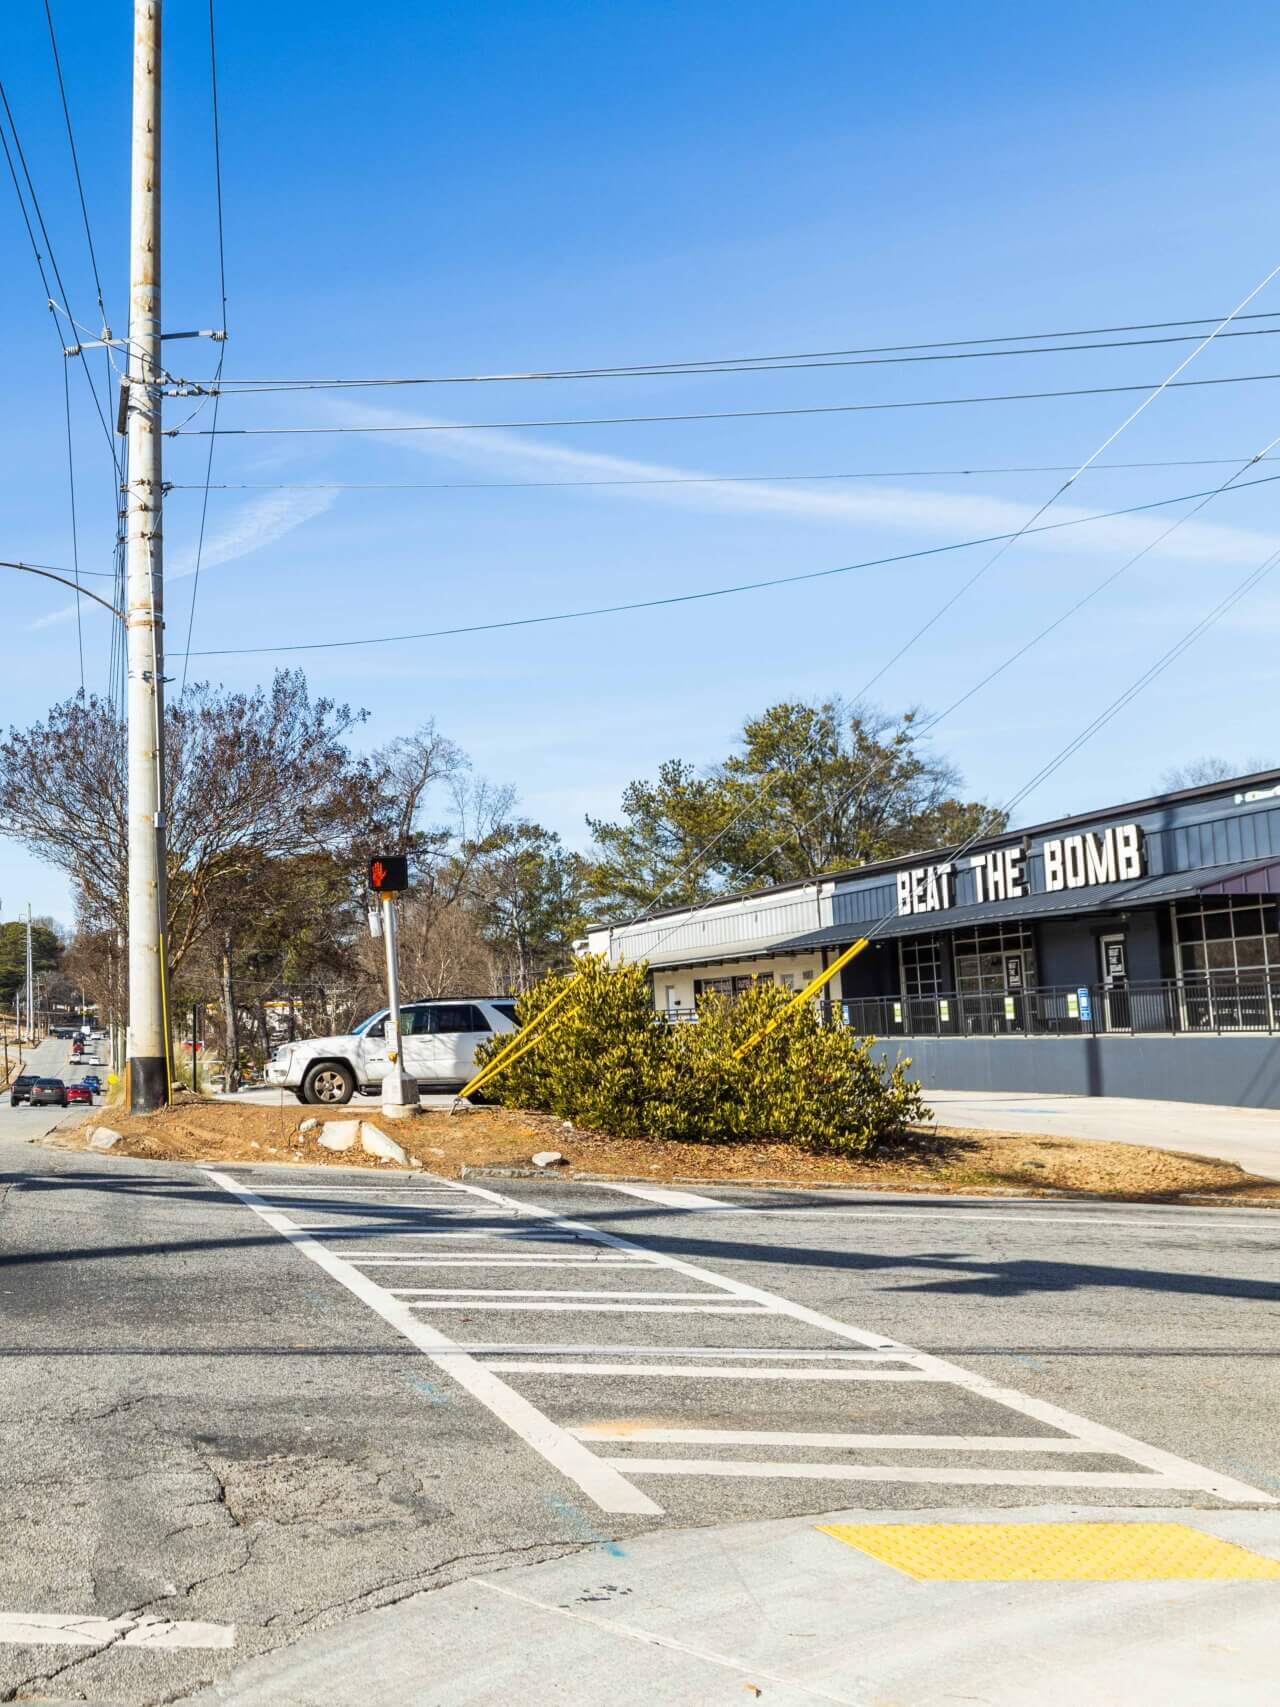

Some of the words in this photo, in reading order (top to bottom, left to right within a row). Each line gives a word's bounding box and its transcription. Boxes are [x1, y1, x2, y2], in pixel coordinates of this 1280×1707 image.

[896, 863, 953, 917] BEAT
[970, 847, 1022, 904] THE
[1043, 823, 1143, 893] BOMB
